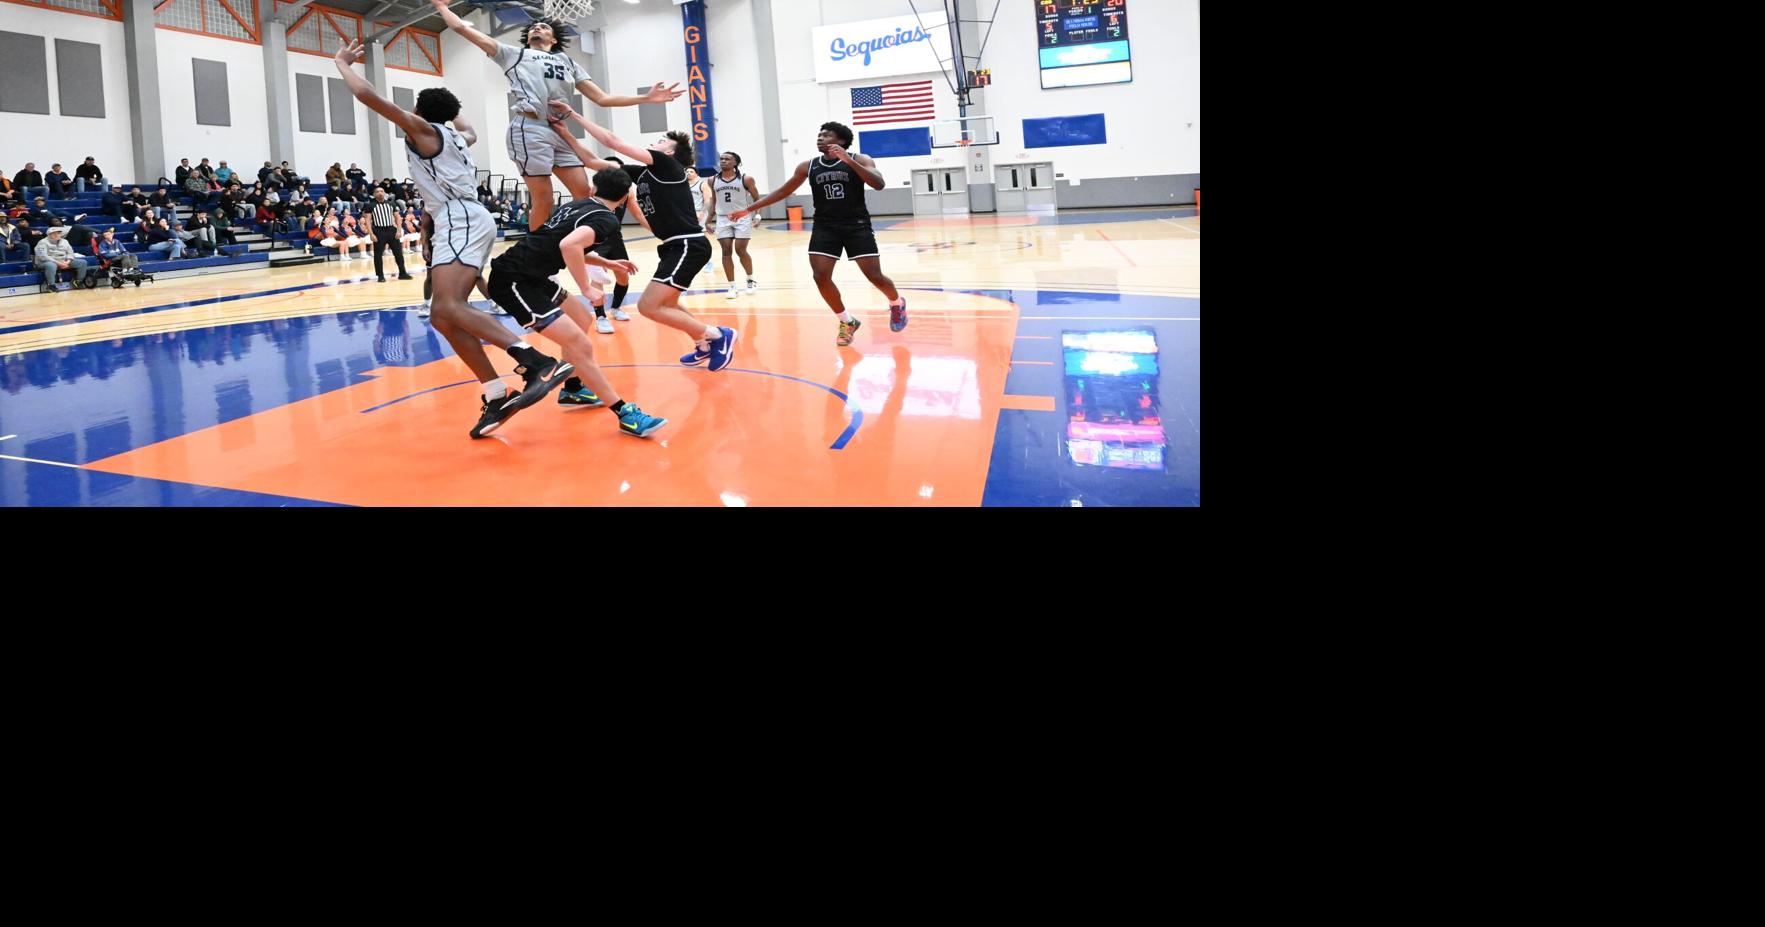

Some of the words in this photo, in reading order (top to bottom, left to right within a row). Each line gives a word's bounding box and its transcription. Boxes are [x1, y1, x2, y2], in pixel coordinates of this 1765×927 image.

[1045, 5, 1056, 14] 17
[830, 26, 932, 66] Sequoias
[544, 62, 566, 81] 35
[684, 25, 709, 141] GIANTS
[724, 191, 732, 203] 2
[823, 182, 845, 200] 12
